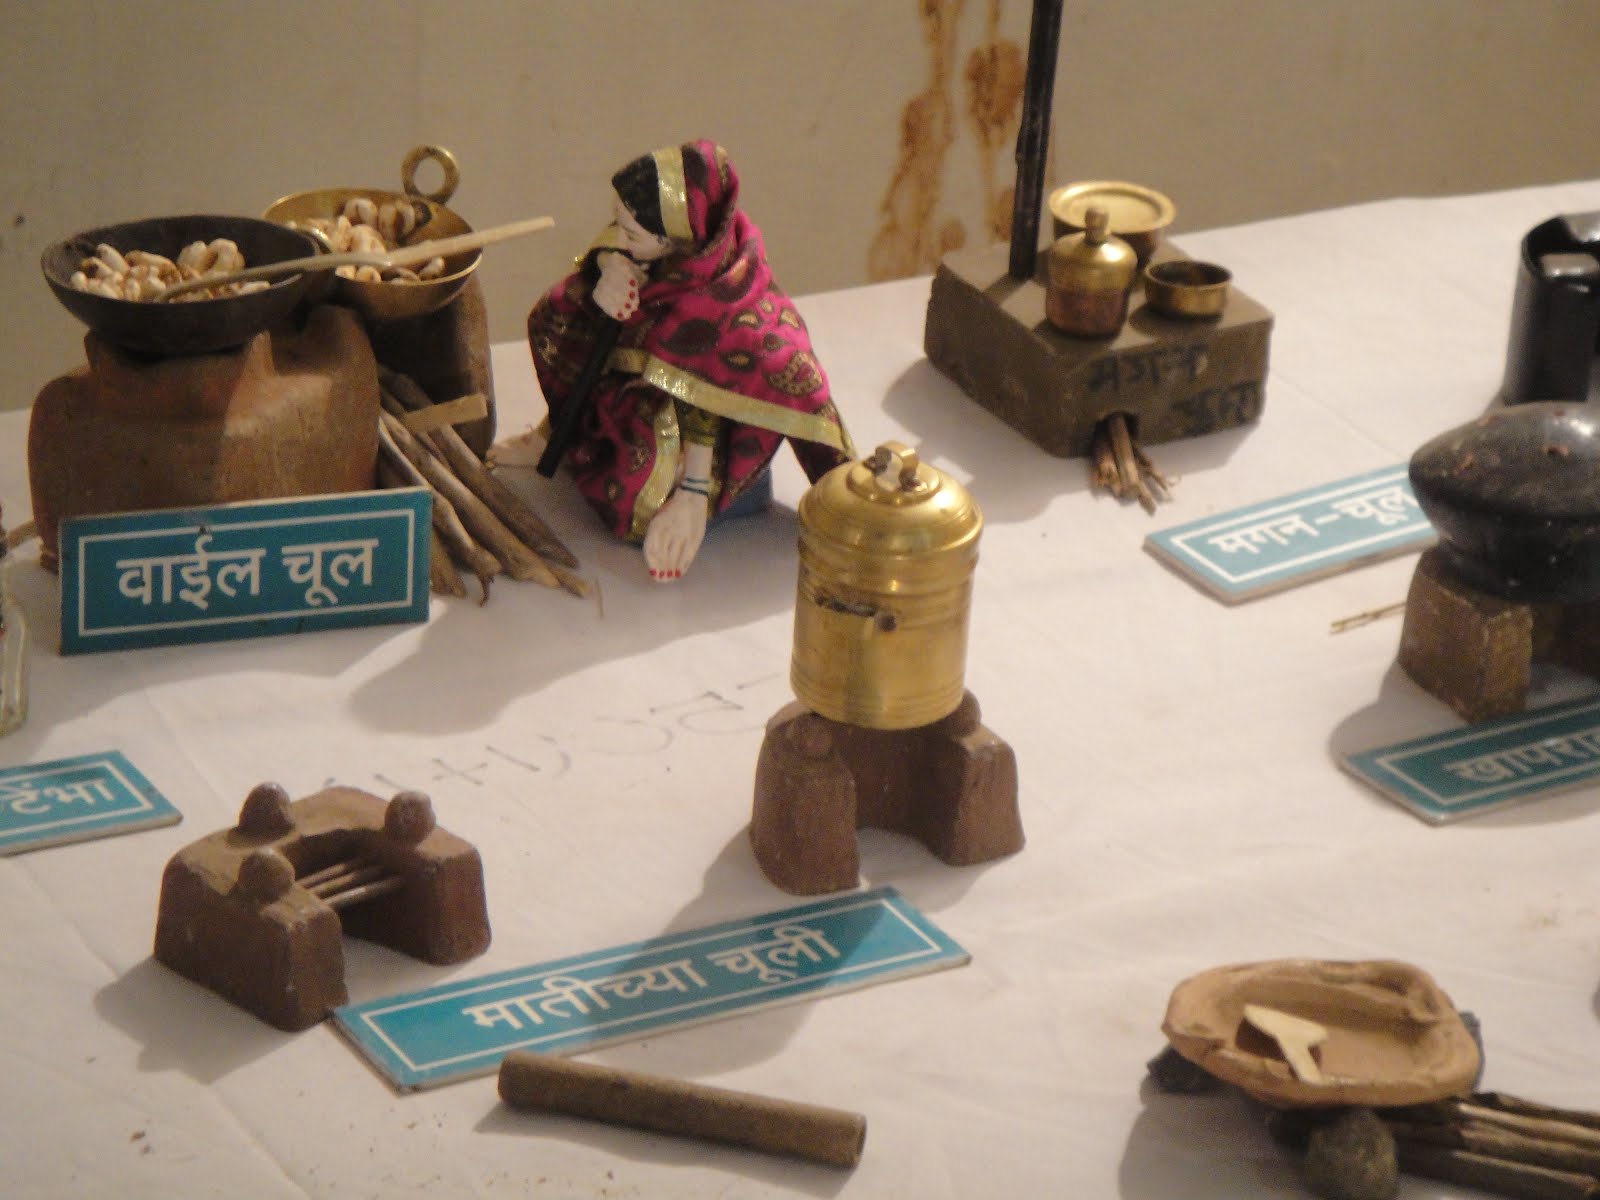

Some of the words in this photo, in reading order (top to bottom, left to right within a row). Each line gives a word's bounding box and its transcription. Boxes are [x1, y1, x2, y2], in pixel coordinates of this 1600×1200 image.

[115, 535, 267, 610] वाईल
[281, 537, 379, 607] चूल
[1442, 726, 1600, 782] खापरा
[461, 958, 708, 1032] मातीच्या
[713, 924, 843, 984] चूली
